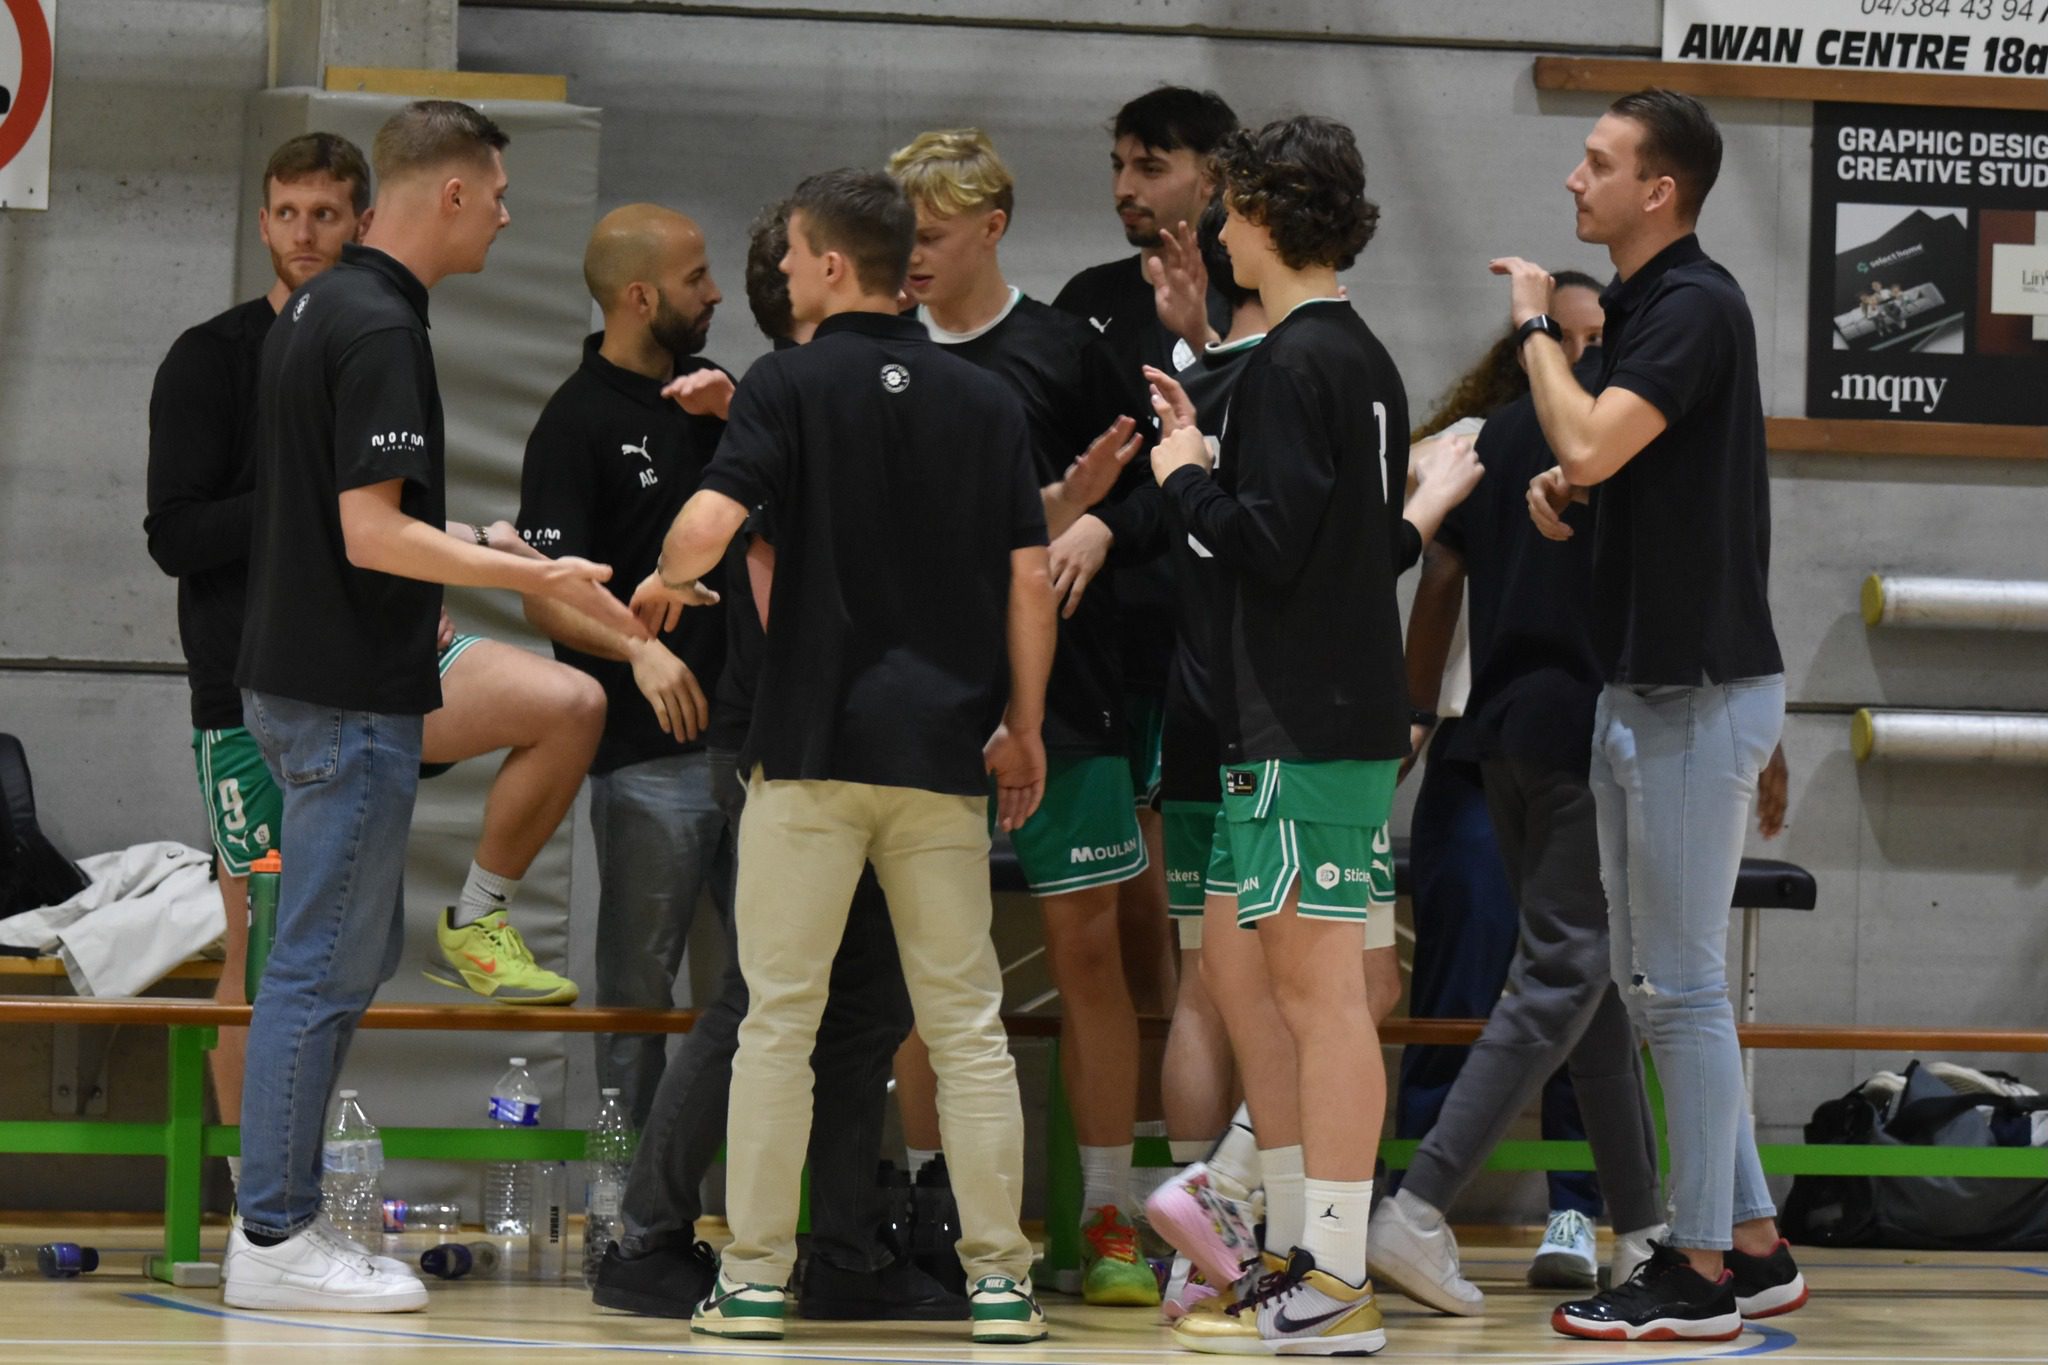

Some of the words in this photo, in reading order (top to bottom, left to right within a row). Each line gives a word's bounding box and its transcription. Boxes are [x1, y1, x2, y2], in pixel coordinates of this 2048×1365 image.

[1960, 0, 1992, 20] 43
[2001, 0, 2033, 21] 94
[1678, 23, 1804, 64] AWAN
[1815, 29, 1971, 70] CENTRE
[1838, 126, 1963, 156] GRAPHIC
[1969, 132, 2048, 160] DESIG
[1837, 155, 1972, 184] CREATIVE
[639, 468, 658, 488] AC
[517, 528, 561, 540] orm
[217, 778, 247, 831] 9
